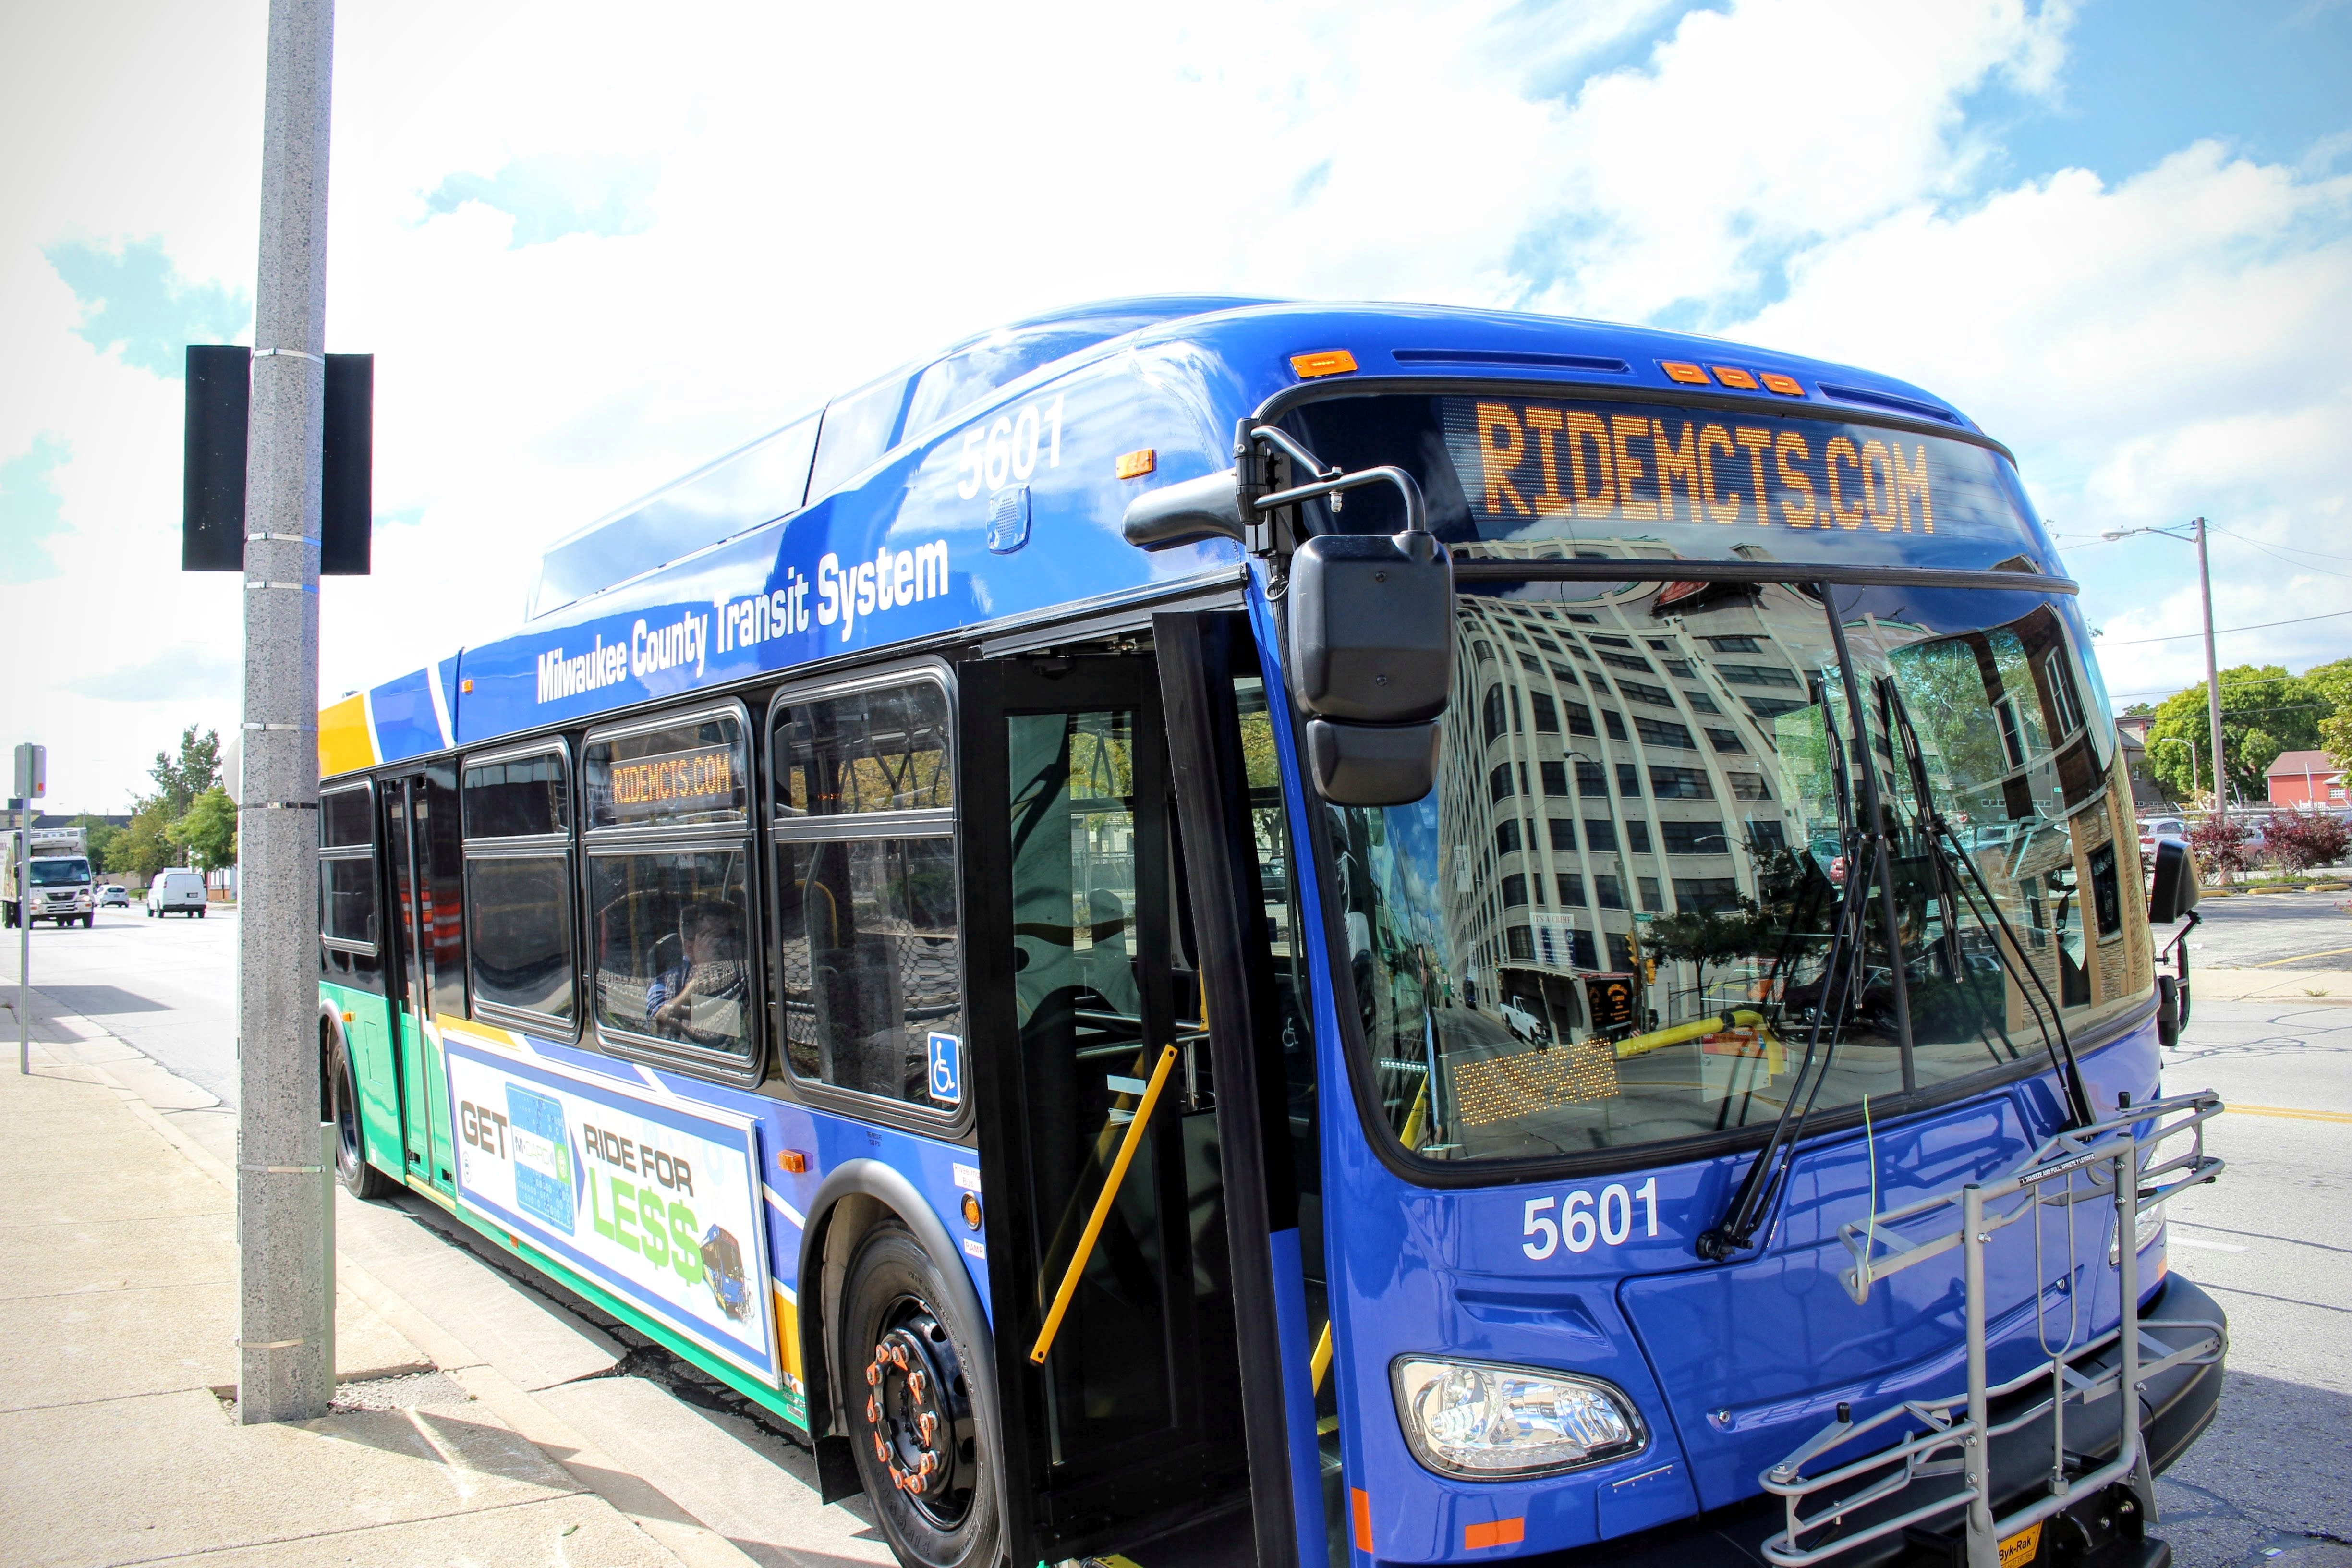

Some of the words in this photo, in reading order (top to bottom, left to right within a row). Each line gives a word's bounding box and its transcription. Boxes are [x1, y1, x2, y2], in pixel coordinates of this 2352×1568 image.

[958, 393, 1064, 500] 5601
[1476, 402, 1934, 534] RIDEMCTS.COM
[537, 634, 627, 704] Milwaukee
[632, 612, 708, 678] County
[714, 567, 809, 654] Transit
[818, 538, 949, 642] System
[614, 753, 730, 803] RIDEMCTS.COM
[1552, 915, 1571, 924] CRIME
[461, 1100, 507, 1159] GET
[583, 1123, 637, 1174] RIDE
[641, 1146, 694, 1197] FOR
[955, 1164, 982, 1180] Kneeling
[963, 1177, 974, 1188] Bus
[2025, 1171, 2043, 1182] SQUEEZE
[2061, 1161, 2076, 1170] APRIETE
[2078, 1154, 2095, 1163] LEVANTE
[1522, 1177, 1658, 1260] 5601
[966, 1241, 983, 1254] RAMP
[1999, 1536, 2031, 1562] Byk-Rak
